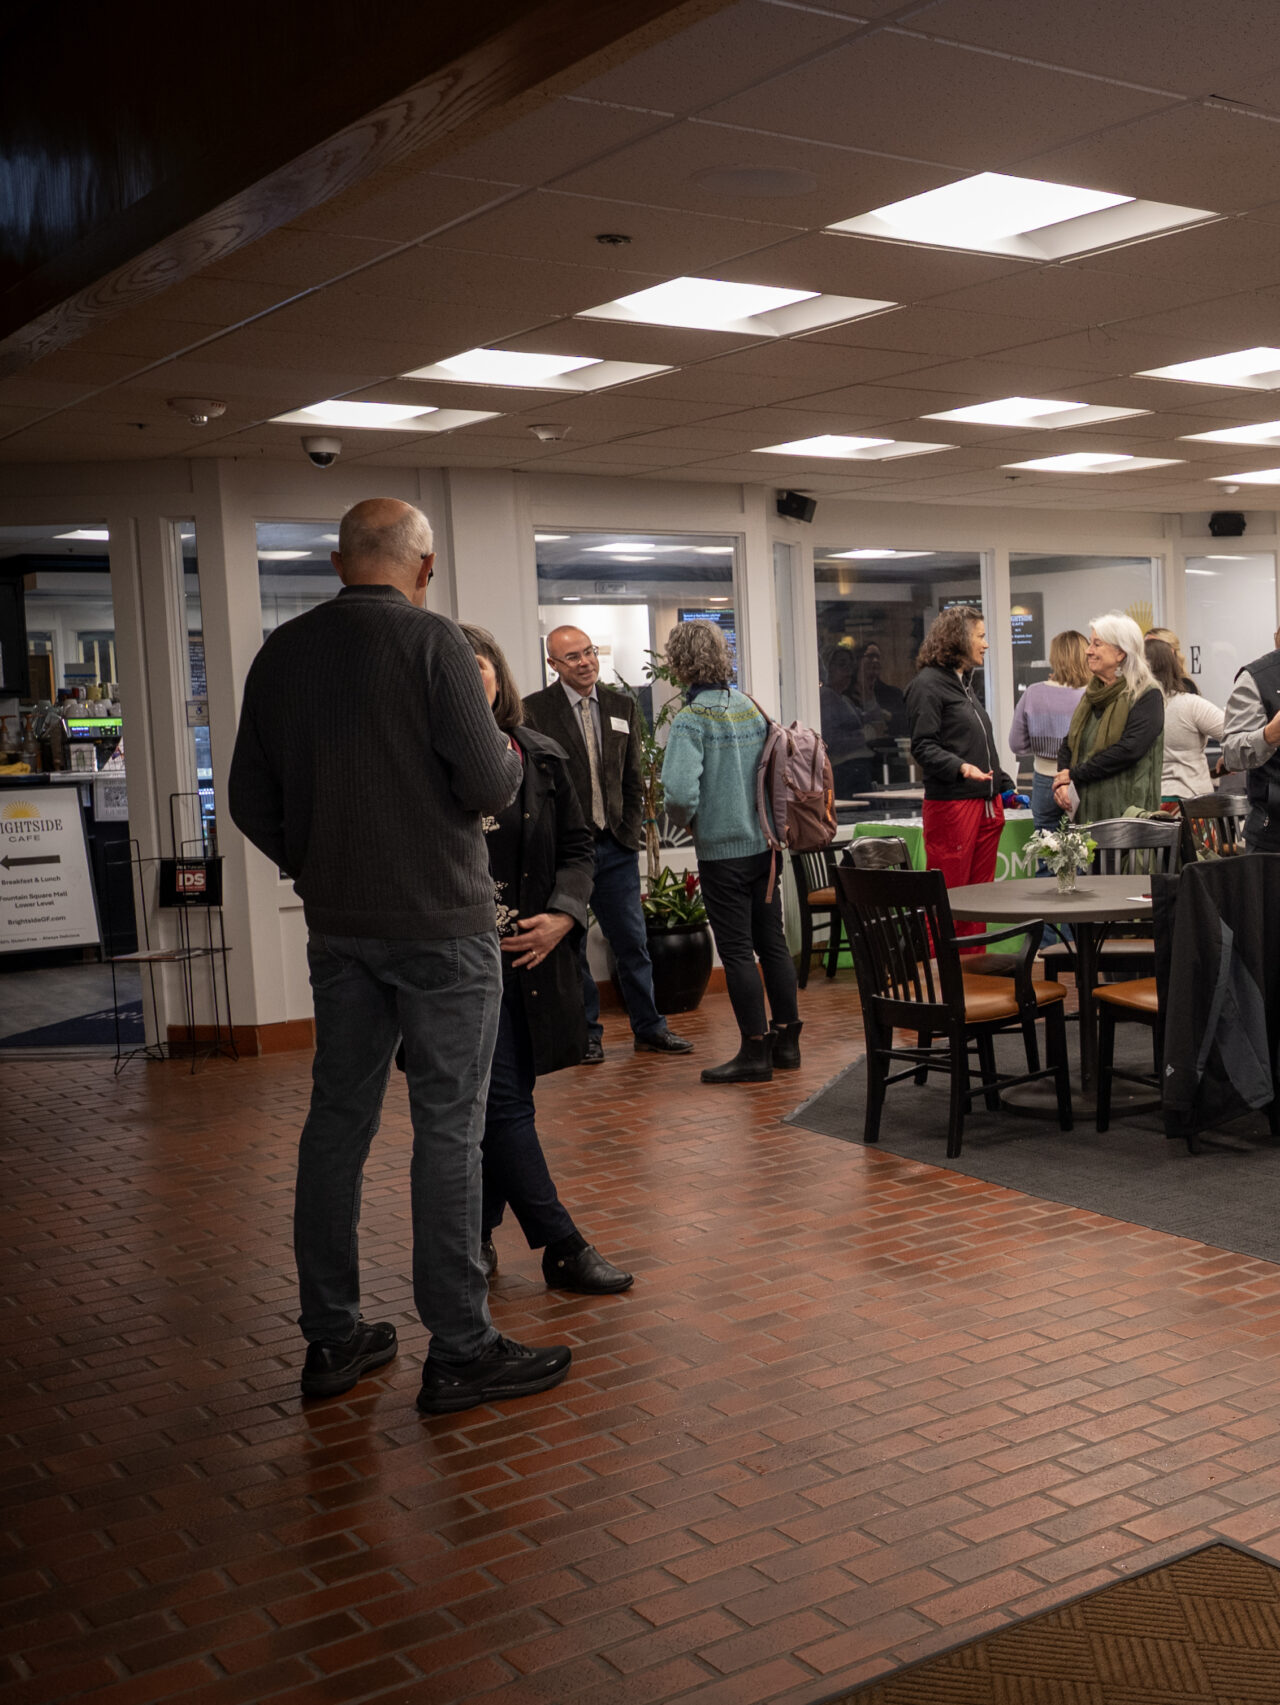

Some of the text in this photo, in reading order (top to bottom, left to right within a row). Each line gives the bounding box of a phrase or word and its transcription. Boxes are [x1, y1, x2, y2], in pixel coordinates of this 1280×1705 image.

[8, 834, 41, 843] CAFE
[1, 877, 33, 886] Breakfast
[178, 873, 205, 886] IDS
[29, 892, 52, 901] Square
